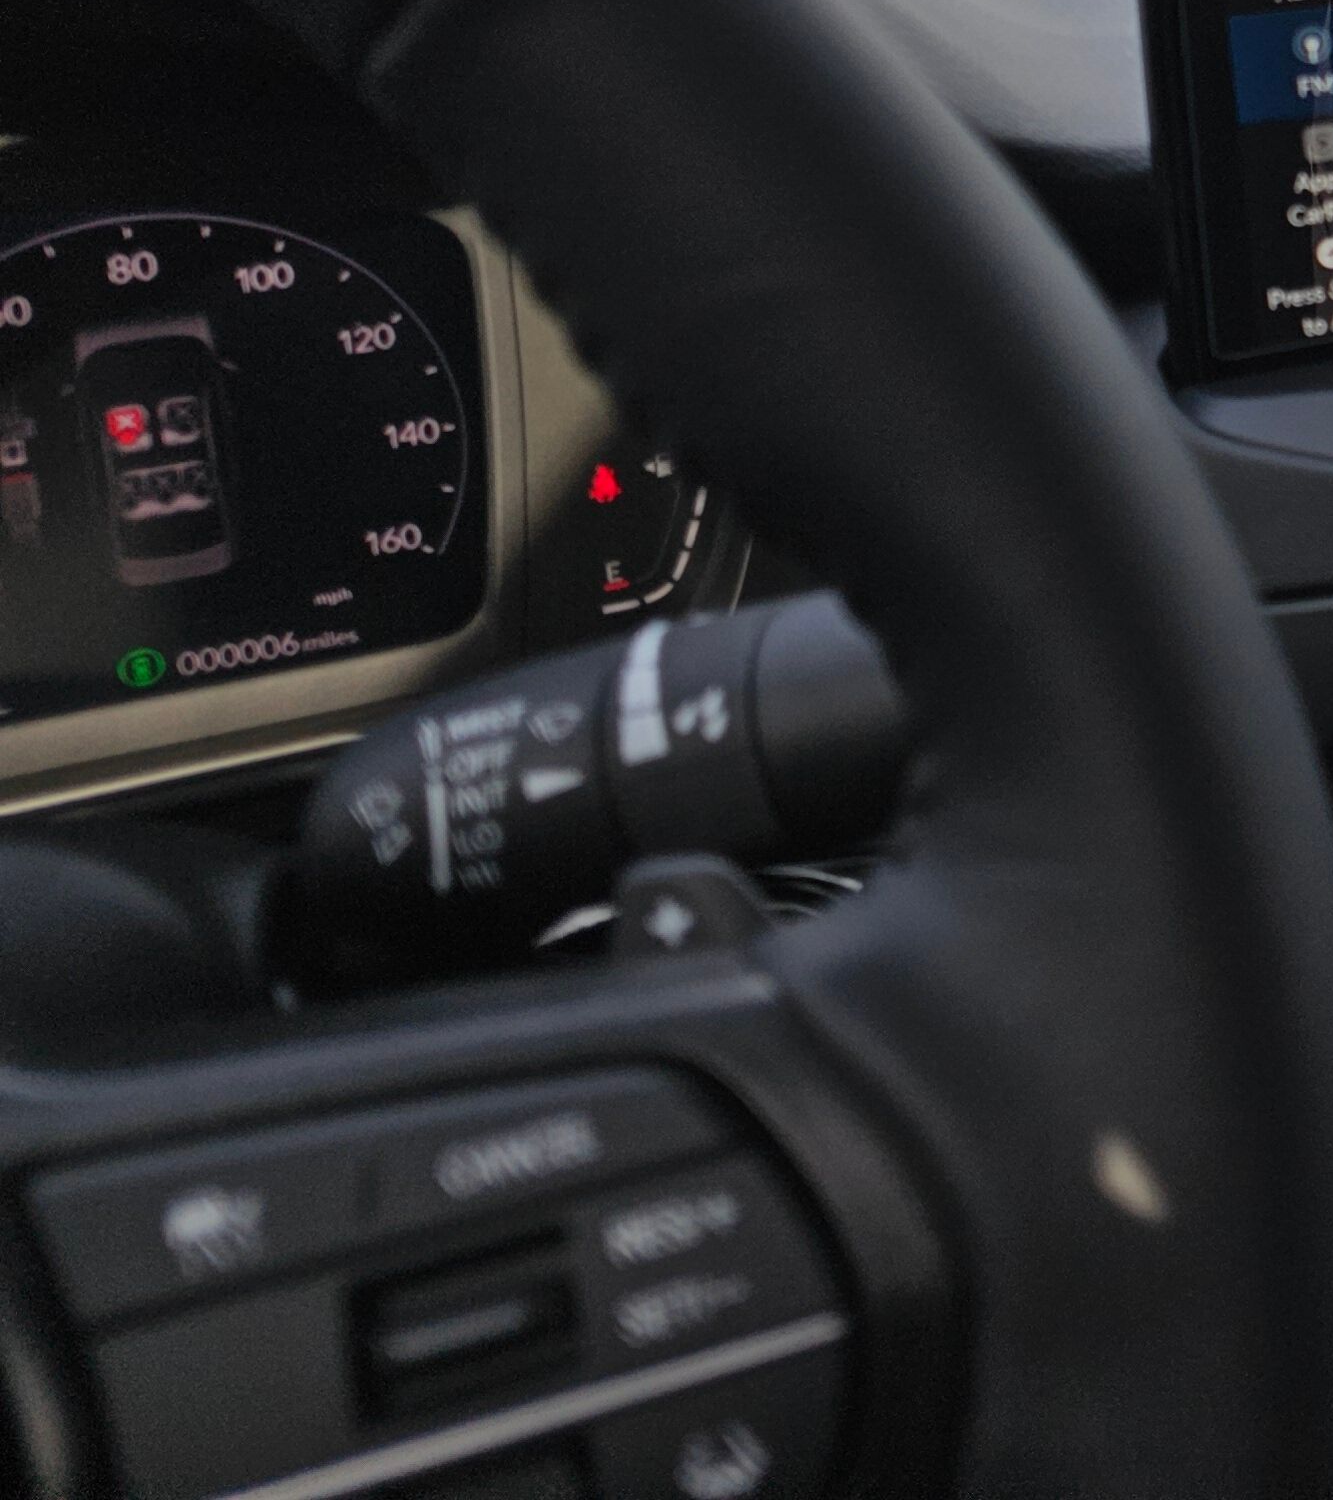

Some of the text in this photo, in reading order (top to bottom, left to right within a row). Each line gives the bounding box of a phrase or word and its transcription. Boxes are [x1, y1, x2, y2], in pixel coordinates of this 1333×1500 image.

[105, 250, 159, 286] 80
[234, 260, 295, 294] 100
[0, 295, 32, 328] 0
[1266, 285, 1326, 311] Press
[336, 321, 397, 356] 120
[1302, 316, 1329, 338] to
[382, 416, 441, 451] 140
[363, 522, 423, 557] 160
[604, 558, 622, 584] E
[176, 628, 361, 677] 000006 miles
